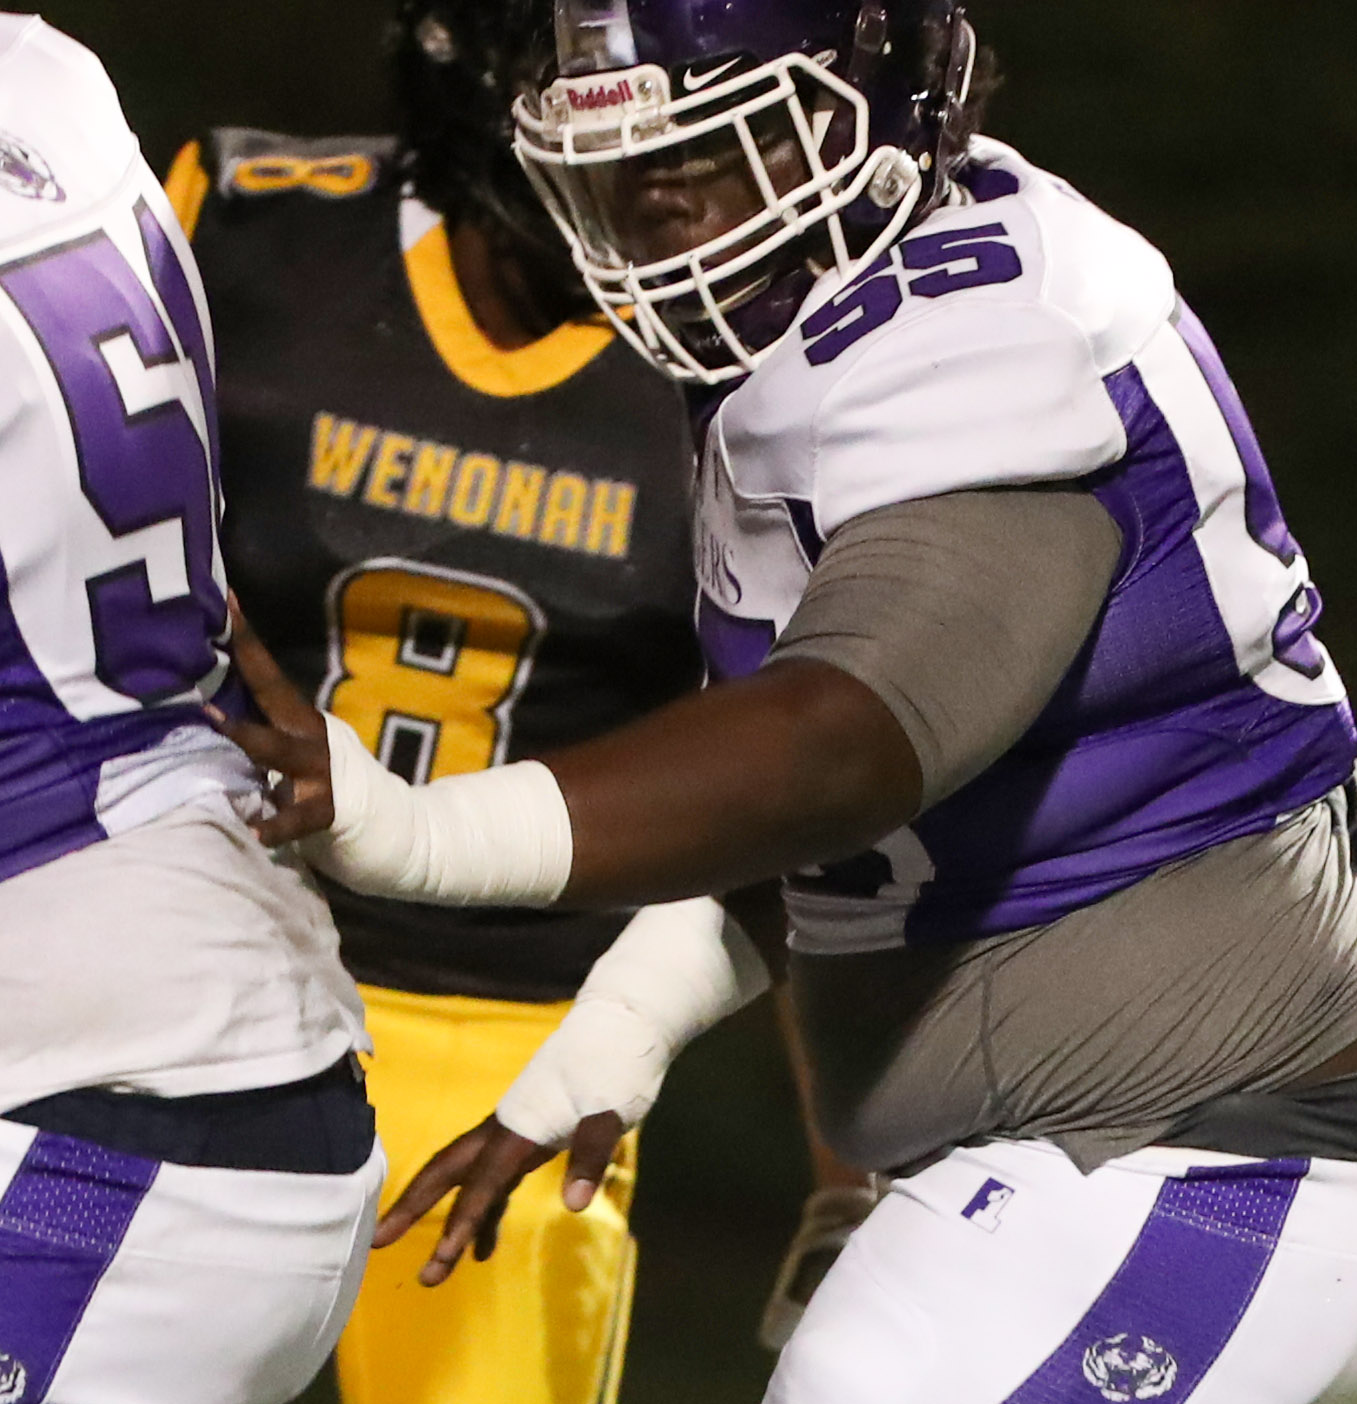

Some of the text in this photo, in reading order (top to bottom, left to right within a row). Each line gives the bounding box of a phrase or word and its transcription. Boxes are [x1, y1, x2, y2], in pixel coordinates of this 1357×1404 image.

[800, 222, 1023, 367] 55
[307, 410, 638, 559] WENONAH
[314, 555, 548, 788] 8
